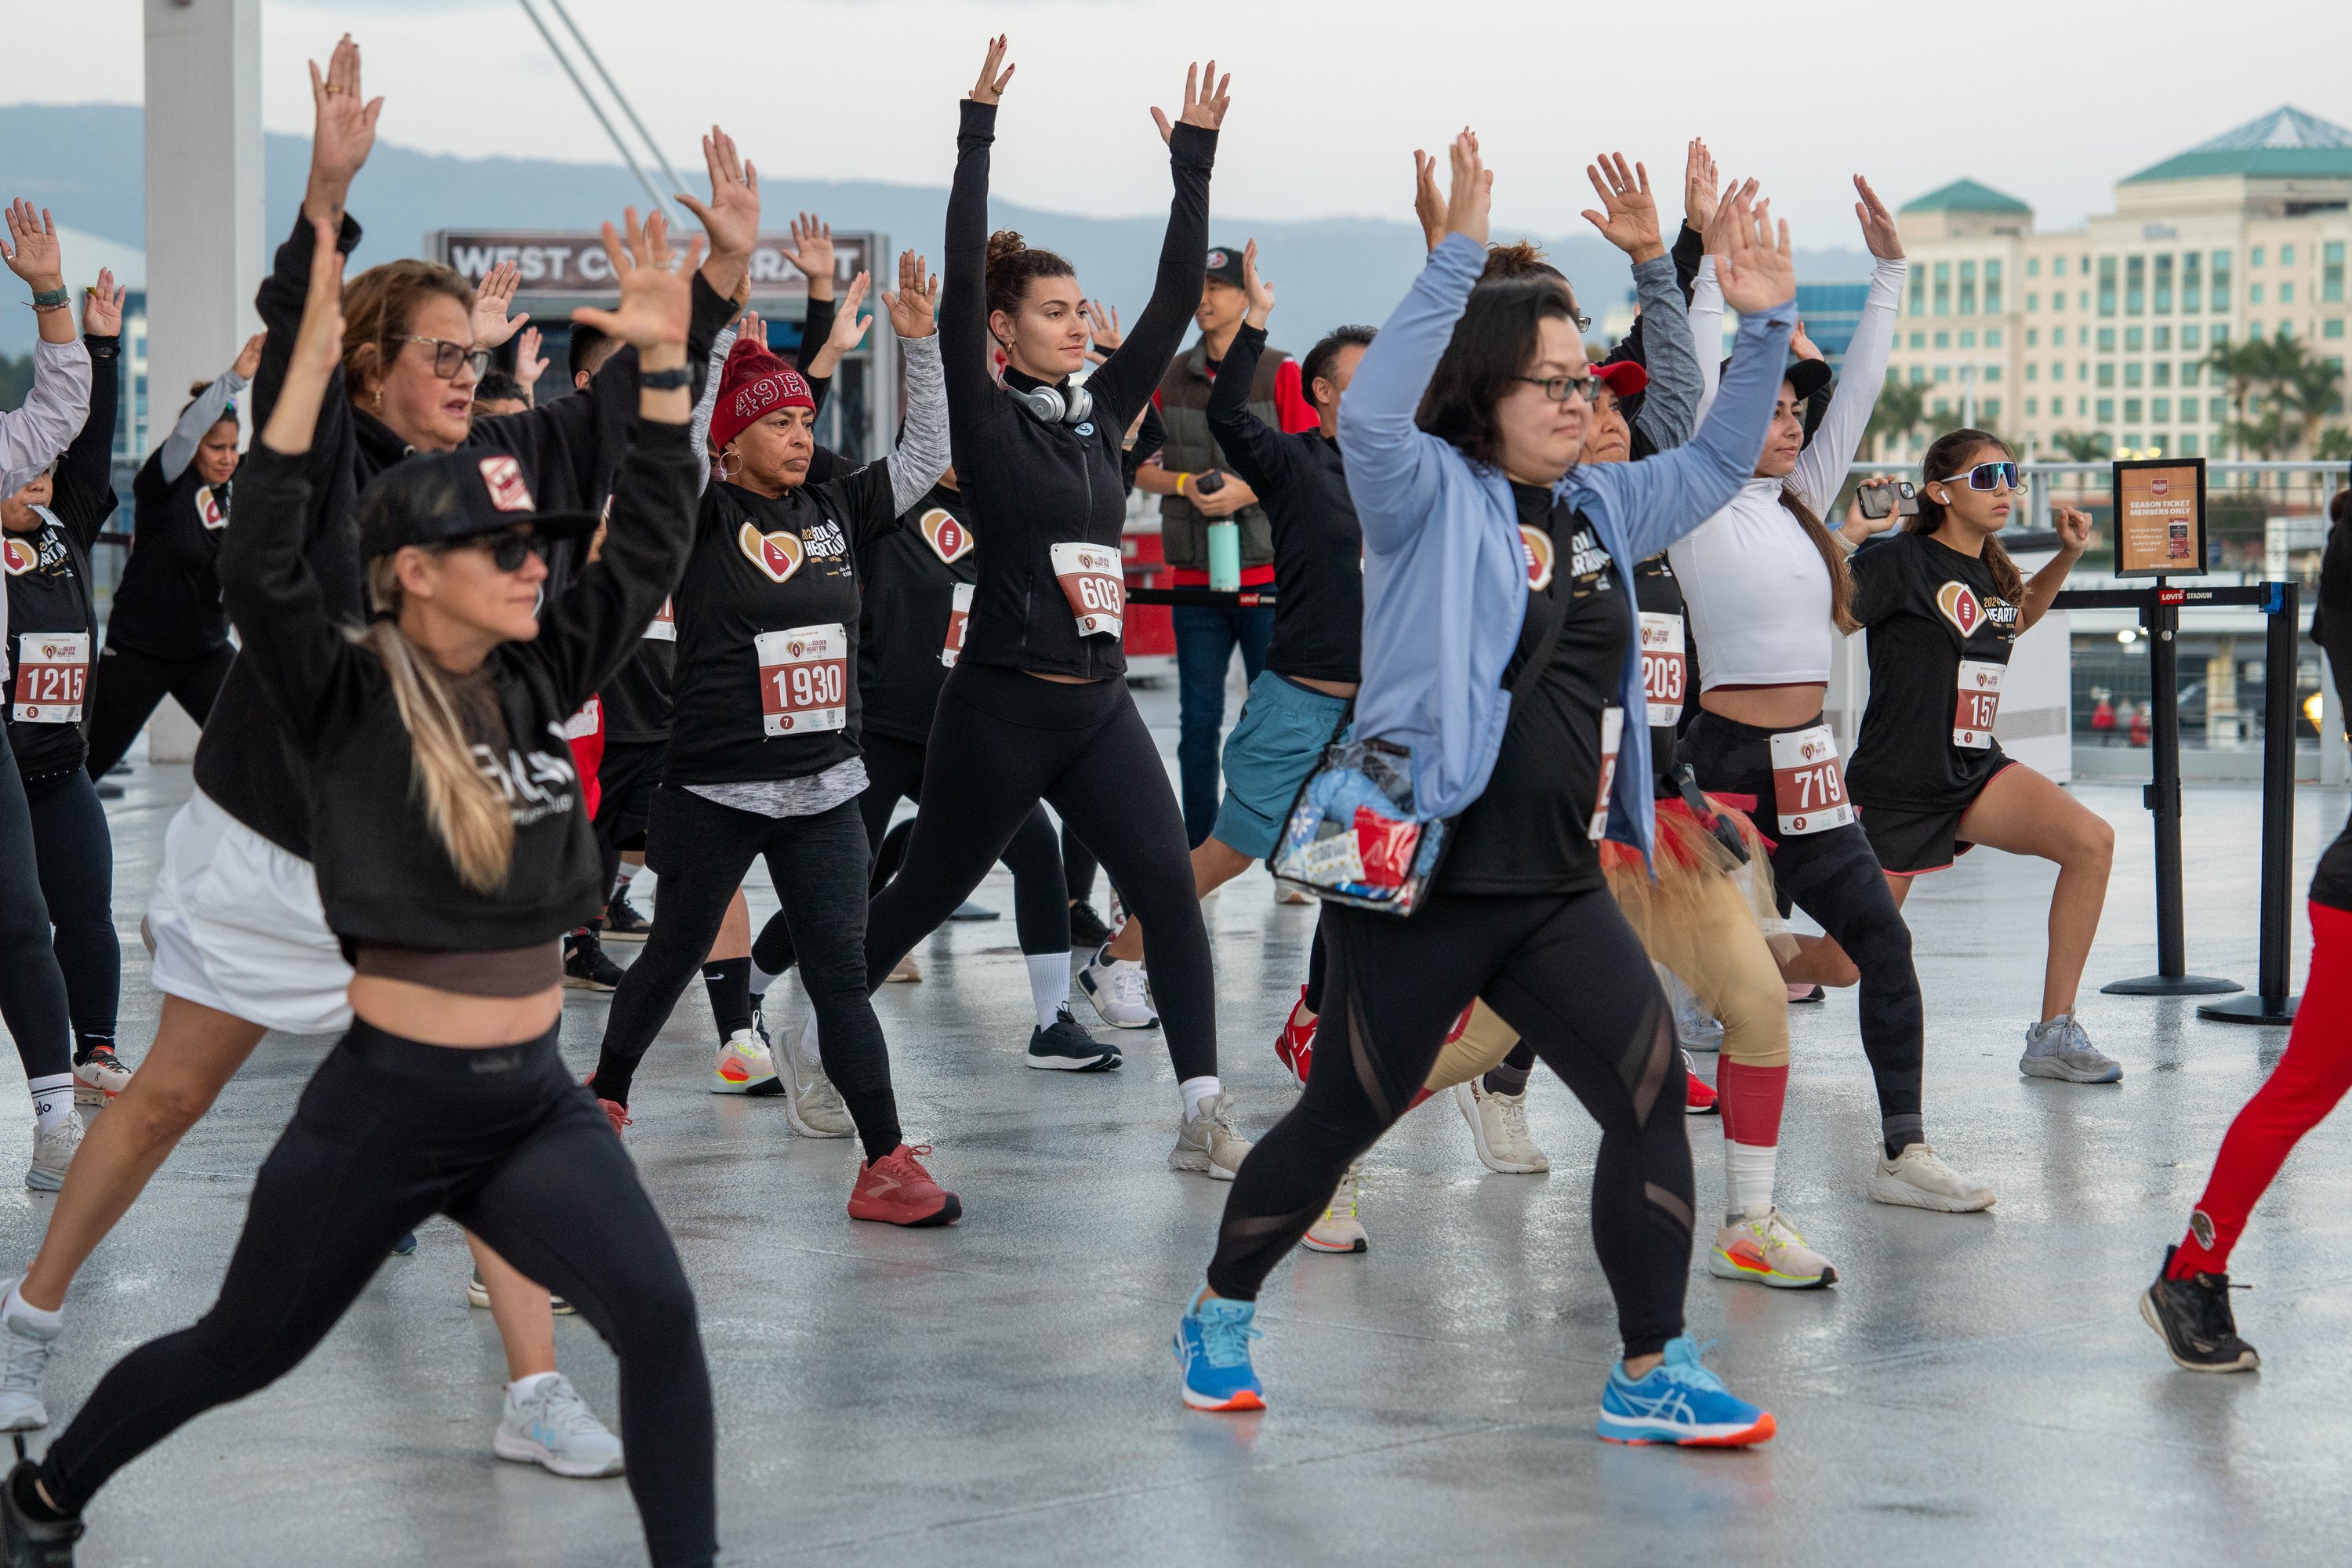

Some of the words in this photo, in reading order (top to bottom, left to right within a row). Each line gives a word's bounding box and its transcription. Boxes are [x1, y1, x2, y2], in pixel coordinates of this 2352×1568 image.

[1079, 577, 1121, 615] 603
[27, 668, 84, 701] 1215
[773, 664, 841, 708] 1930
[784, 718, 789, 728] 7
[1970, 695, 1997, 728] 157
[1795, 764, 1841, 808] 719
[1797, 819, 1803, 829] 3
[35, 1101, 53, 1116] alo
